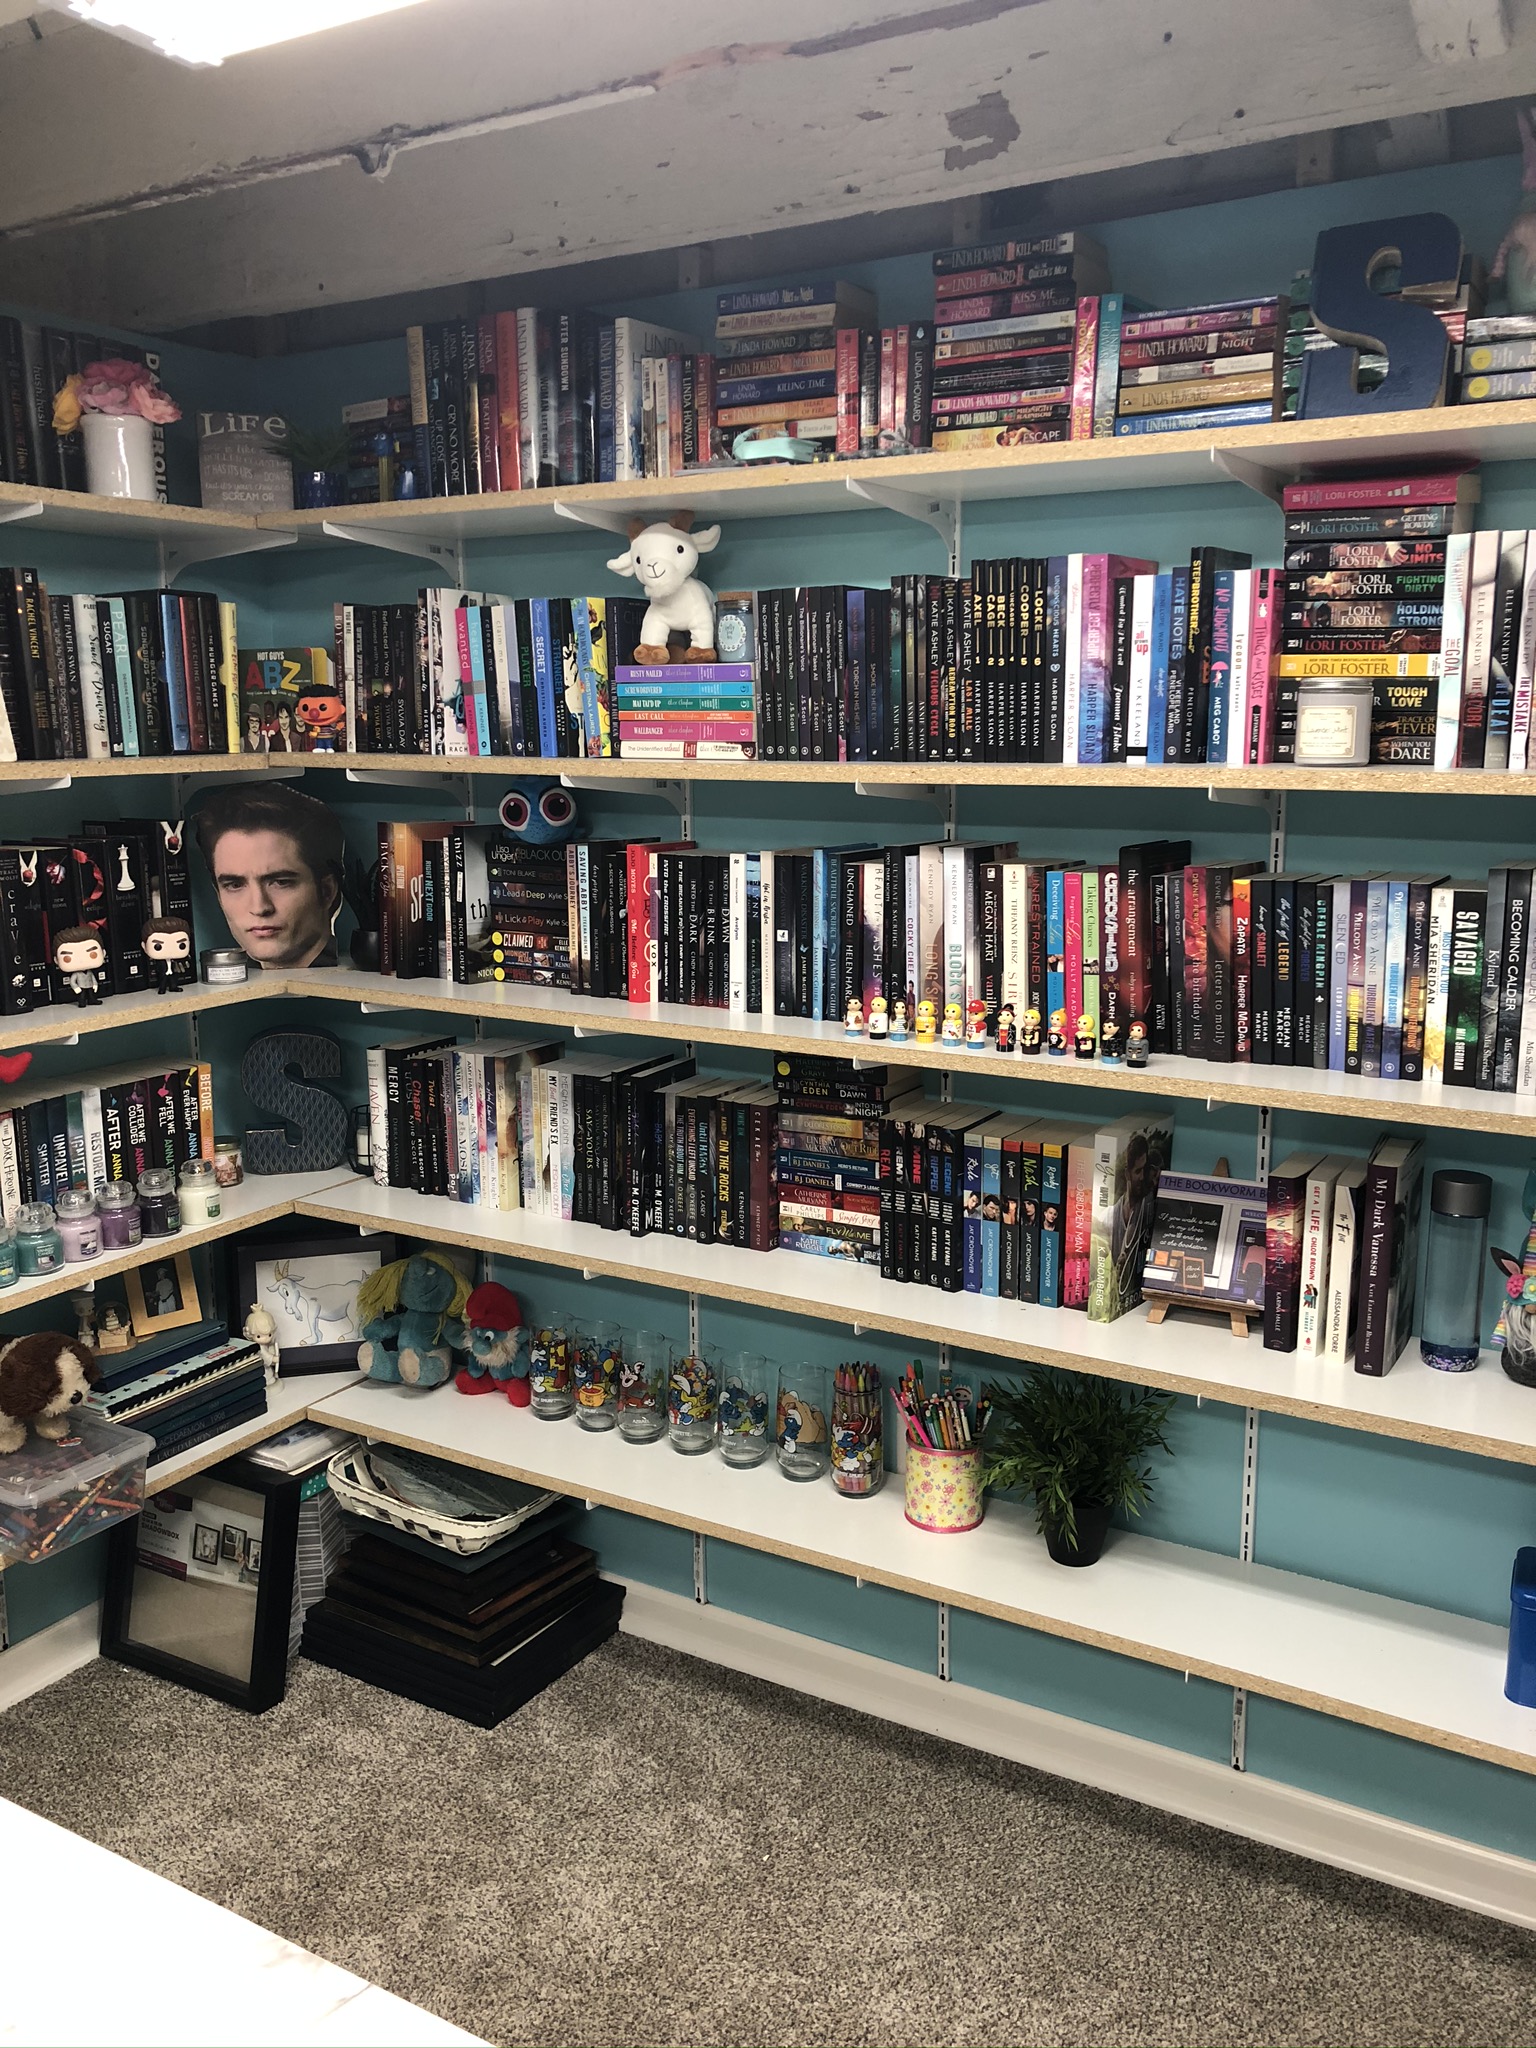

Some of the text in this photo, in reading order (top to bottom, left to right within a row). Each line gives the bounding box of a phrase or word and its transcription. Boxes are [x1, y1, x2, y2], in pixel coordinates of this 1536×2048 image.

[560, 315, 568, 344] AFTER
[1137, 335, 1207, 359] LINDA HOWARD
[1221, 338, 1255, 349] NIGHT
[615, 326, 631, 438] LINDA HOWARD
[777, 378, 826, 392] KILLING TIME
[914, 351, 924, 421] LINDA HOWARD
[1142, 390, 1210, 408] LINDA HOWARD
[683, 378, 694, 455] LINDA HOWARD
[447, 404, 460, 481] CRY NO MORE
[1025, 431, 1060, 443] ESCAPE
[222, 492, 275, 502] SCREAM OR
[1310, 522, 1380, 534] LORI FOSTER
[1401, 513, 1438, 522] GETTING
[1403, 520, 1436, 530] ROWDY
[1339, 555, 1381, 566] FOSTER
[1346, 546, 1374, 556] LORI
[1350, 584, 1394, 595] FOSTER
[1358, 575, 1387, 585] LORI
[1396, 574, 1445, 585] FIGHTING
[1404, 583, 1436, 593] DIRTY
[974, 594, 982, 626] AXEL
[987, 594, 996, 628] CAGE
[997, 594, 1006, 628] BECK
[1020, 584, 1029, 637] COOPER
[1034, 590, 1043, 632] LOCKE
[1171, 577, 1186, 660] HATE NOTES
[1340, 615, 1384, 626] FOSTER
[1347, 605, 1376, 616] LORI
[103, 621, 113, 654] SUGAR
[111, 610, 128, 664] PEARL
[335, 615, 343, 645] BOYS
[458, 622, 471, 670] wanted
[931, 601, 939, 667] KATIE ASHLEY
[964, 600, 972, 673] KATIE ASHLEY
[257, 651, 285, 661] HOT GUYS
[521, 646, 531, 688] PLAYER
[536, 636, 546, 674] SECRET
[552, 638, 563, 694] STRANGER
[1303, 663, 1391, 675] LORI FOSTER
[1444, 649, 1461, 679] GOAL
[930, 669, 939, 737] VICIOUS CYCLE
[1387, 686, 1429, 697] TOUGH
[1391, 697, 1423, 708] LOVE
[1513, 676, 1531, 734] THE MISTAKE
[633, 726, 664, 735] WALLBANGER
[634, 712, 665, 720] LAST CALL
[1395, 722, 1437, 734] FEVER
[1489, 698, 1511, 736] DEAL
[1390, 746, 1432, 760] DARE
[381, 841, 389, 873] BACK
[520, 847, 550, 860] BLACK
[517, 869, 537, 878] BLAKE
[579, 851, 588, 912] SAVING ABBY
[846, 868, 855, 926] UNCHAINED
[1051, 878, 1061, 921] Deceiving
[1125, 869, 1139, 957] the arrangement
[502, 933, 534, 949] CLAIMED
[689, 914, 698, 944] DARK
[706, 908, 716, 945] BRINK
[721, 908, 730, 944] DAWN
[984, 890, 994, 963] MEGAN HART
[1030, 872, 1041, 984] UNRESTRAINED
[1236, 917, 1249, 955] ZAPATA
[1315, 899, 1327, 989] CREOLE KINGPIN
[1334, 913, 1348, 966] SILENCED
[1452, 910, 1480, 976] SAVAGED
[872, 936, 883, 979] ASHES
[906, 917, 915, 975] COCKY CHEF
[1256, 931, 1267, 968] SCARLETT
[1277, 942, 1290, 982] LEGEND
[1352, 912, 1365, 978] MELODY ANNE
[1427, 915, 1440, 1005] MIA SHERIDAN
[1505, 899, 1525, 1012] BECOMING CALDER
[1485, 948, 1501, 988] Kyland
[1213, 959, 1226, 1046] letters to molly
[1237, 974, 1248, 1008] HARPER
[1276, 1010, 1284, 1045] MARCH
[1283, 1007, 1291, 1049] MEGHAN
[199, 1073, 213, 1112] BEFORE
[368, 1076, 382, 1125] HAVEN
[387, 1066, 400, 1104] MERCY
[412, 1080, 423, 1124] Chaser
[802, 1087, 829, 1096] EDEN
[839, 1090, 867, 1099] DAWN
[128, 1105, 139, 1145] COLLIDED
[158, 1106, 168, 1128] FELL
[854, 1108, 884, 1117] NIGHT
[52, 1133, 69, 1185] UNRAVEL
[70, 1134, 87, 1176] IGNITE
[90, 1131, 105, 1172] RESTORE
[106, 1108, 124, 1181] AFTER ANNA
[164, 1138, 175, 1166] ANNA
[188, 1132, 199, 1160] ANNA
[37, 1143, 51, 1187] SHATTER
[719, 1139, 729, 1203] ON THE ROCKS
[880, 1148, 891, 1179] REAL
[911, 1145, 922, 1185] MINE
[930, 1155, 939, 1192] RIPPED
[943, 1155, 953, 1197] LEGEND
[1163, 1177, 1256, 1198] THE BOOKWORM
[1074, 1159, 1087, 1254] THE FORBIDDEN MAN
[1181, 1215, 1198, 1224] walk
[1204, 1219, 1218, 1227] mile
[1369, 1177, 1389, 1278] My Dark Vanessa
[1179, 1242, 1208, 1251] bookstore
[156, 1422, 231, 1462] LACEDAEMON 1997
[141, 1521, 181, 1541] SHADOWBOX
